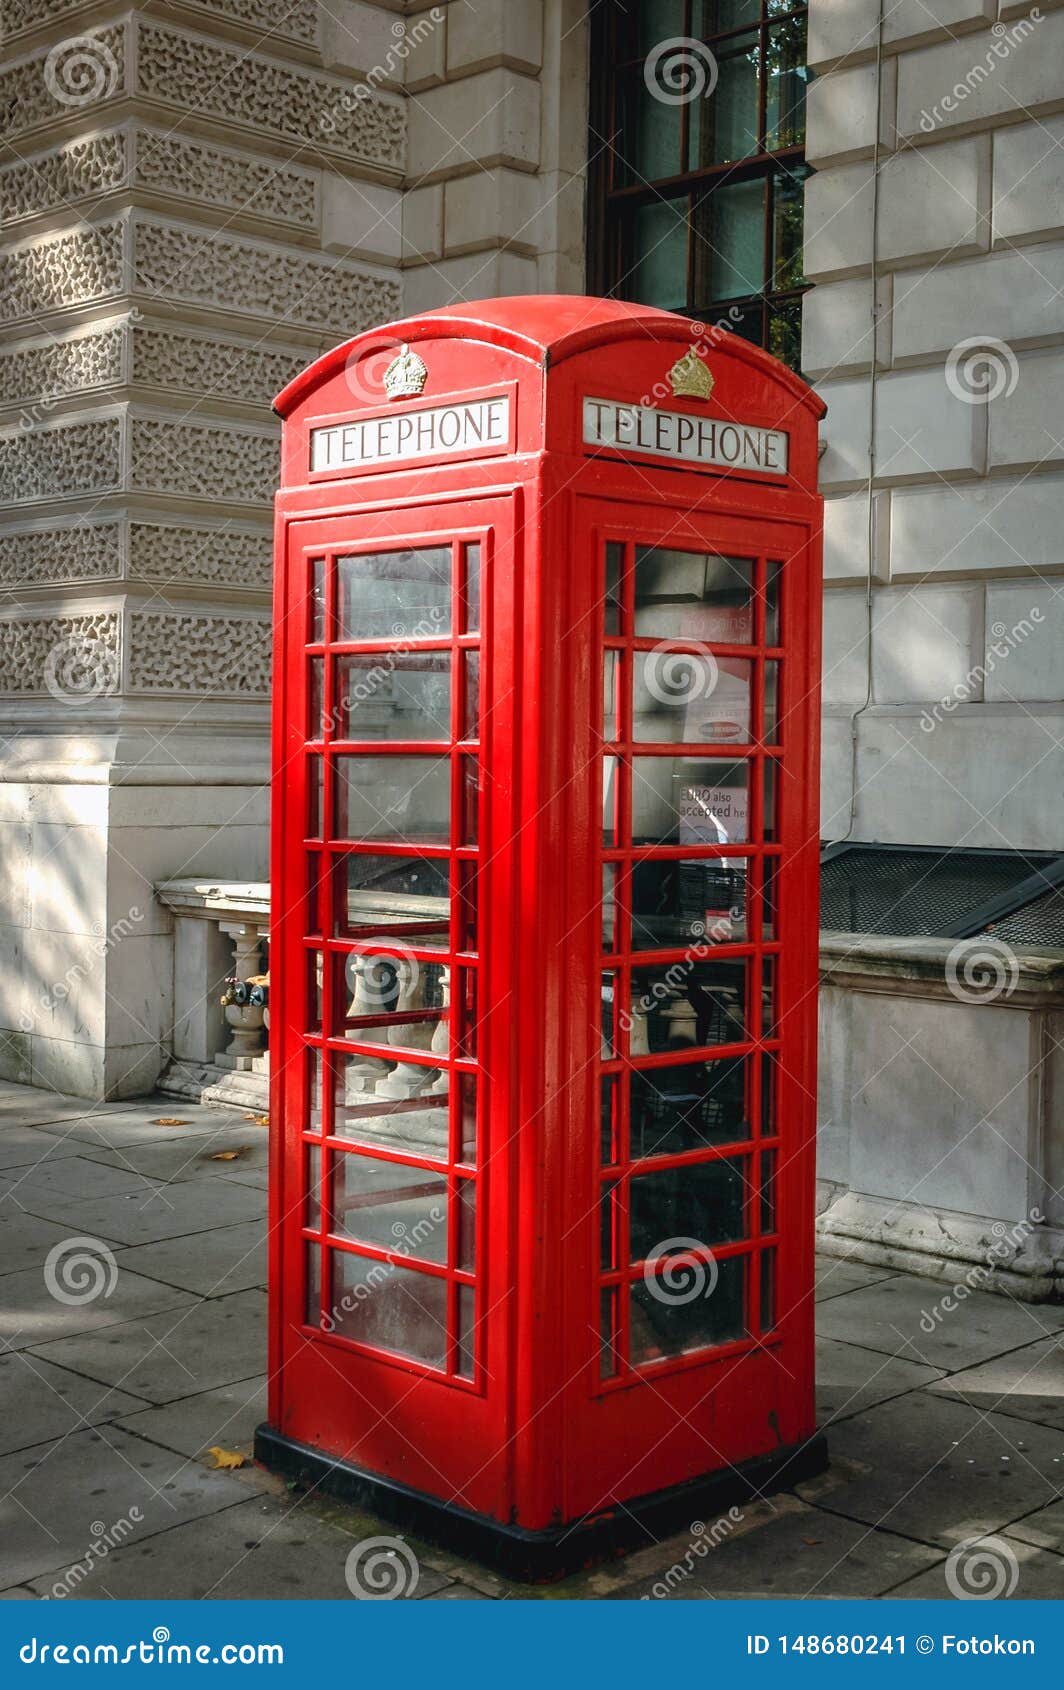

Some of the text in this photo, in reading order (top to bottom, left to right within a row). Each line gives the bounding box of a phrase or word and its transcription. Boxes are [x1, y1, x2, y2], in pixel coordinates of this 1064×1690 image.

[320, 402, 503, 465] TELEPHONE
[587, 401, 779, 468] TELEPHONE
[680, 804, 731, 819] accepted
[713, 791, 732, 802] also
